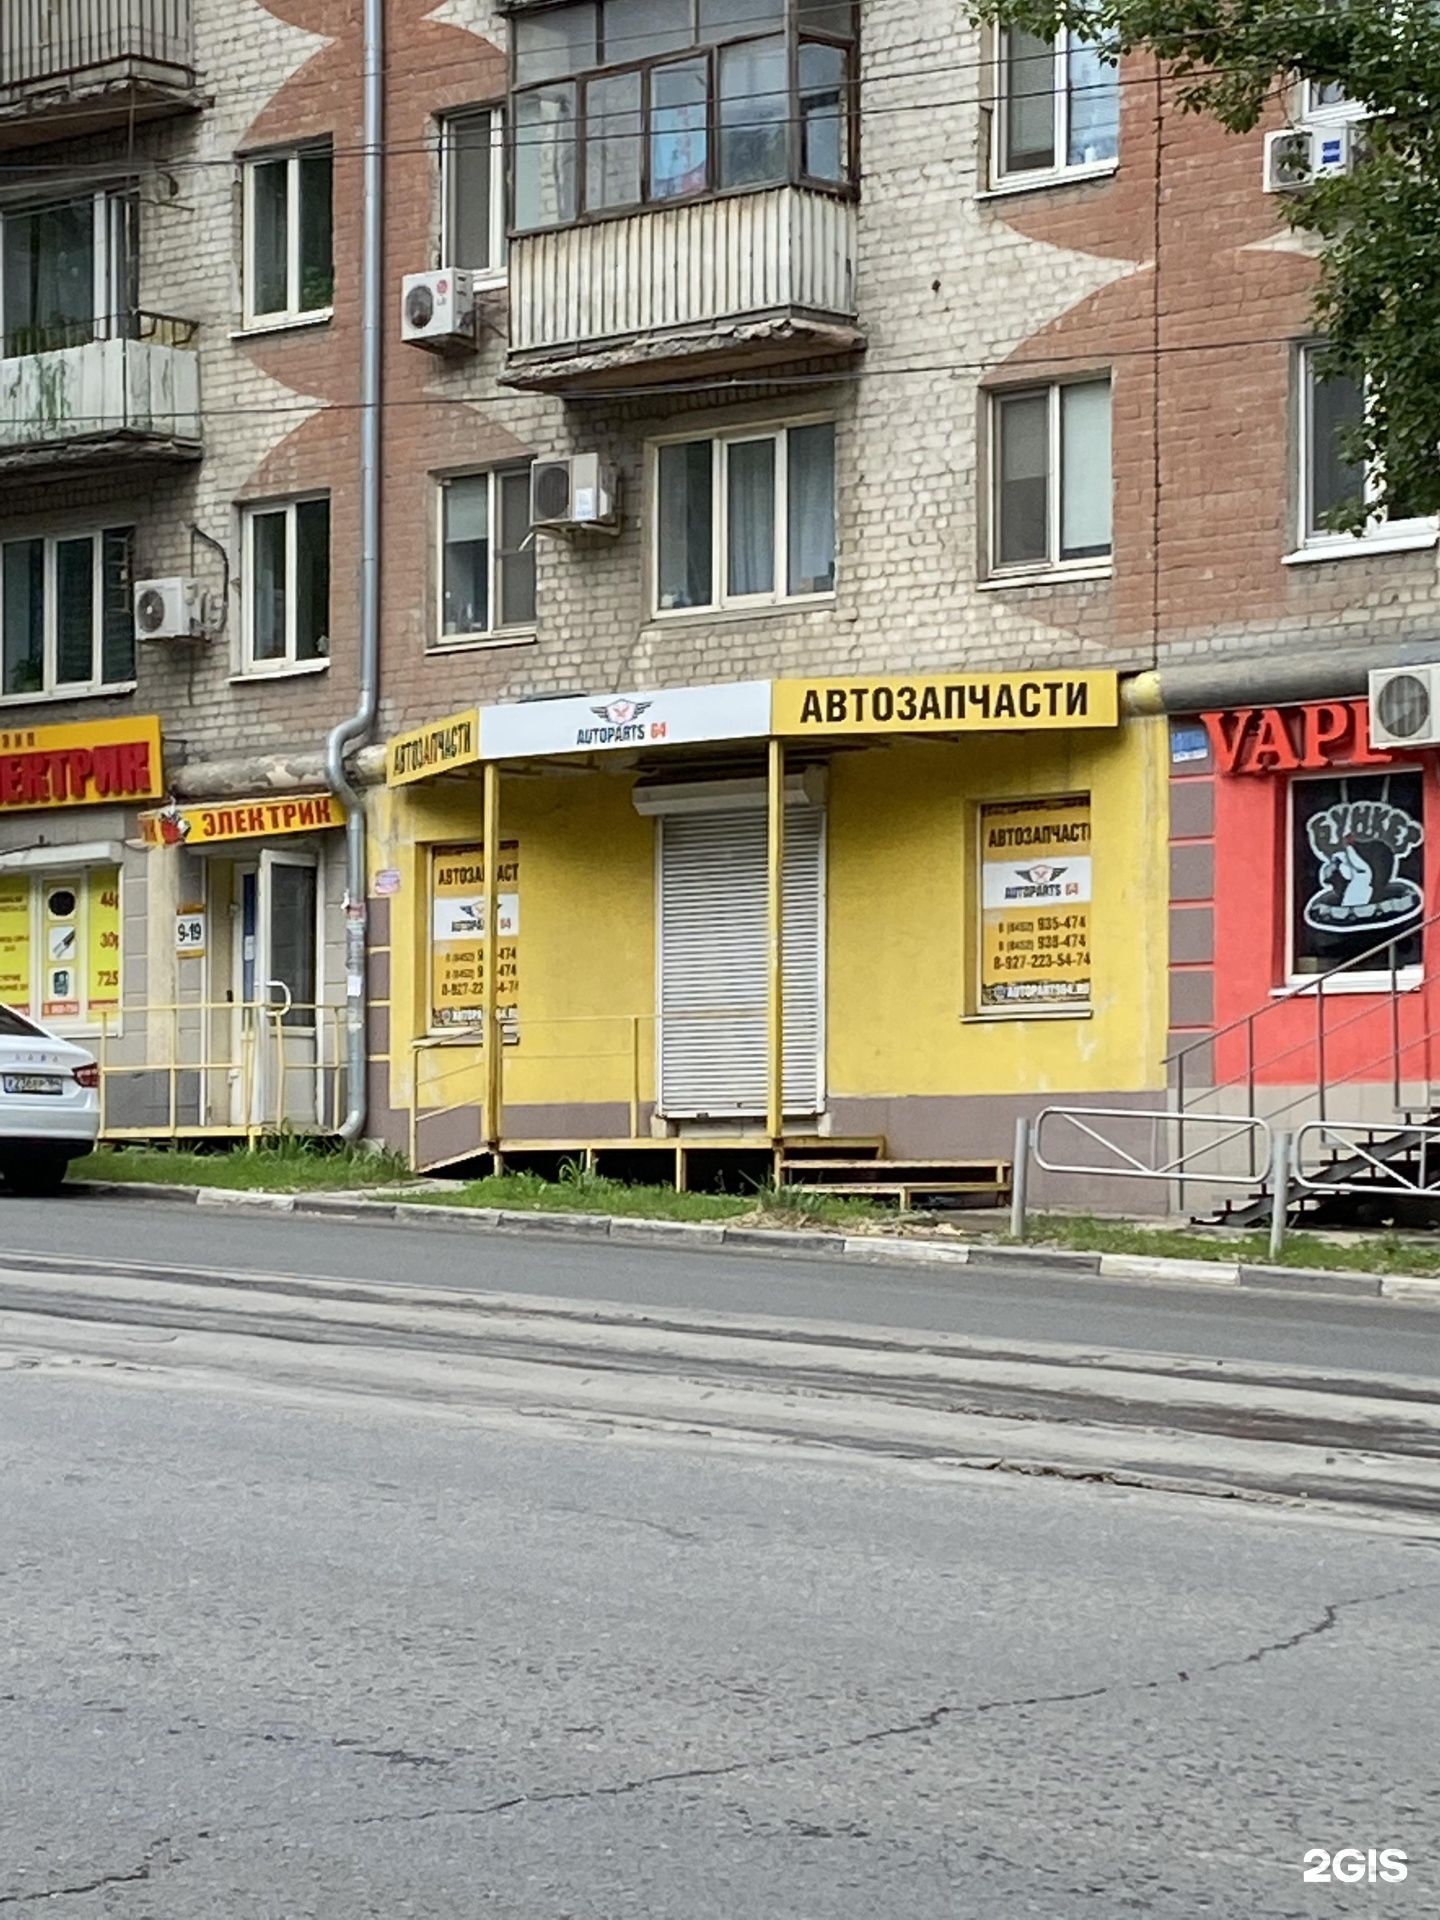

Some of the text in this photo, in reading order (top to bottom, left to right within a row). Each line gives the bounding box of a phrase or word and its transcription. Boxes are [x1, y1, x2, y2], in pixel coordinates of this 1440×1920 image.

[799, 682, 1088, 724] АВТОЗАПЧАСТИ
[393, 721, 471, 777] АВТОЗАПЧАСТИ
[576, 722, 667, 746] AUTOPARTS 64
[202, 798, 332, 838] ЭЛЕКТРИК
[1308, 803, 1422, 853] БУНКЕР
[178, 922, 202, 942] 9-19
